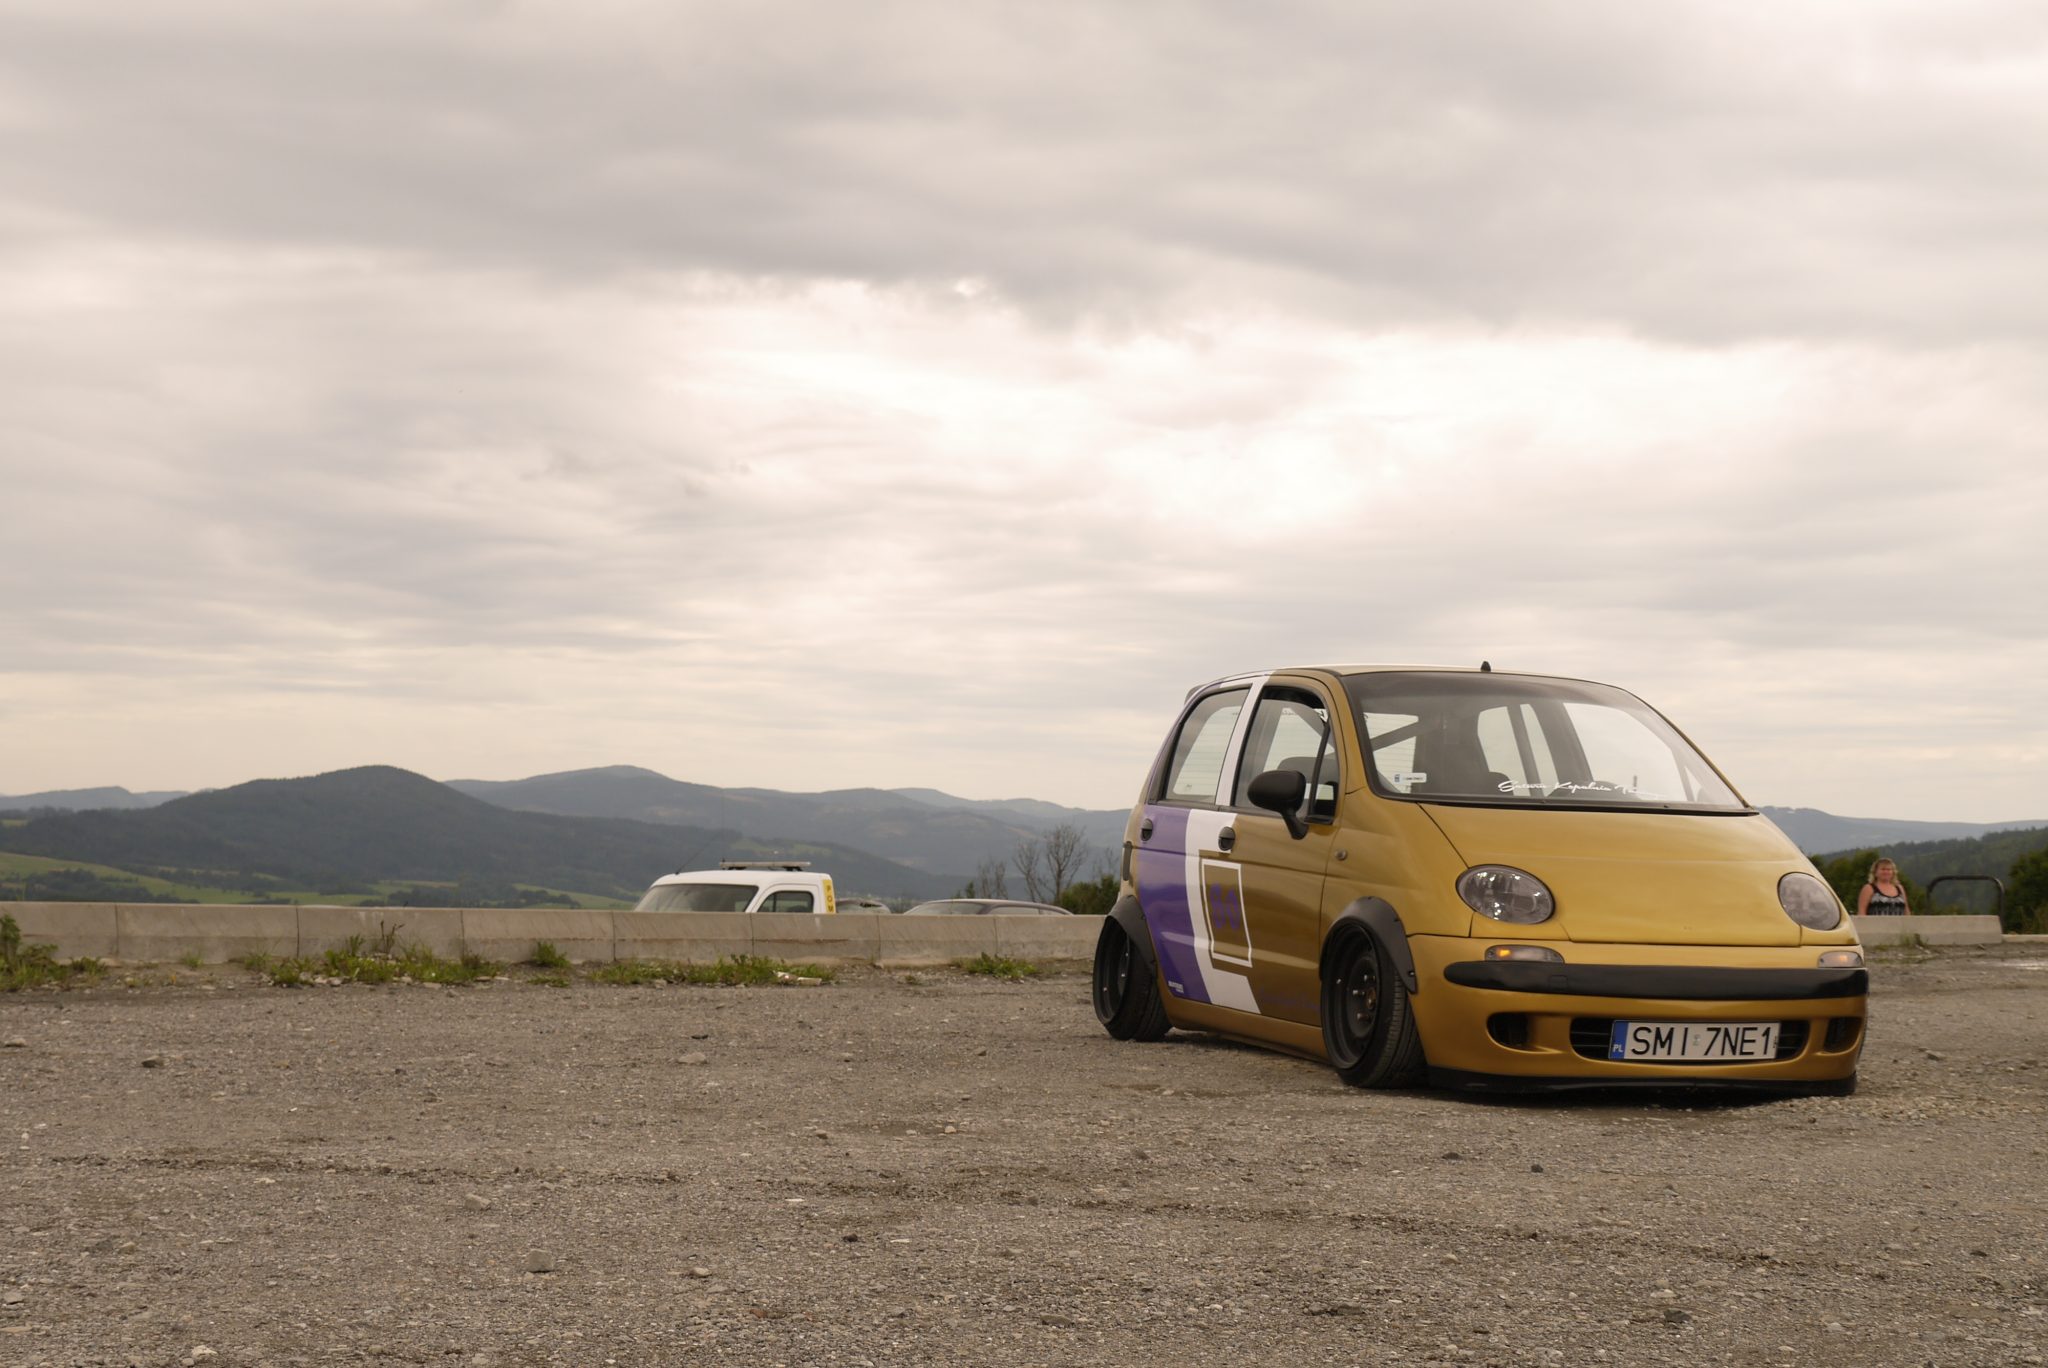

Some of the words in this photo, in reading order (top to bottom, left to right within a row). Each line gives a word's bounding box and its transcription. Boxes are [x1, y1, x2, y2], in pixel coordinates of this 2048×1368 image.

[1612, 1043, 1624, 1053] PL
[1631, 1026, 1689, 1056] SMI
[1704, 1026, 1771, 1056] 7NE1
